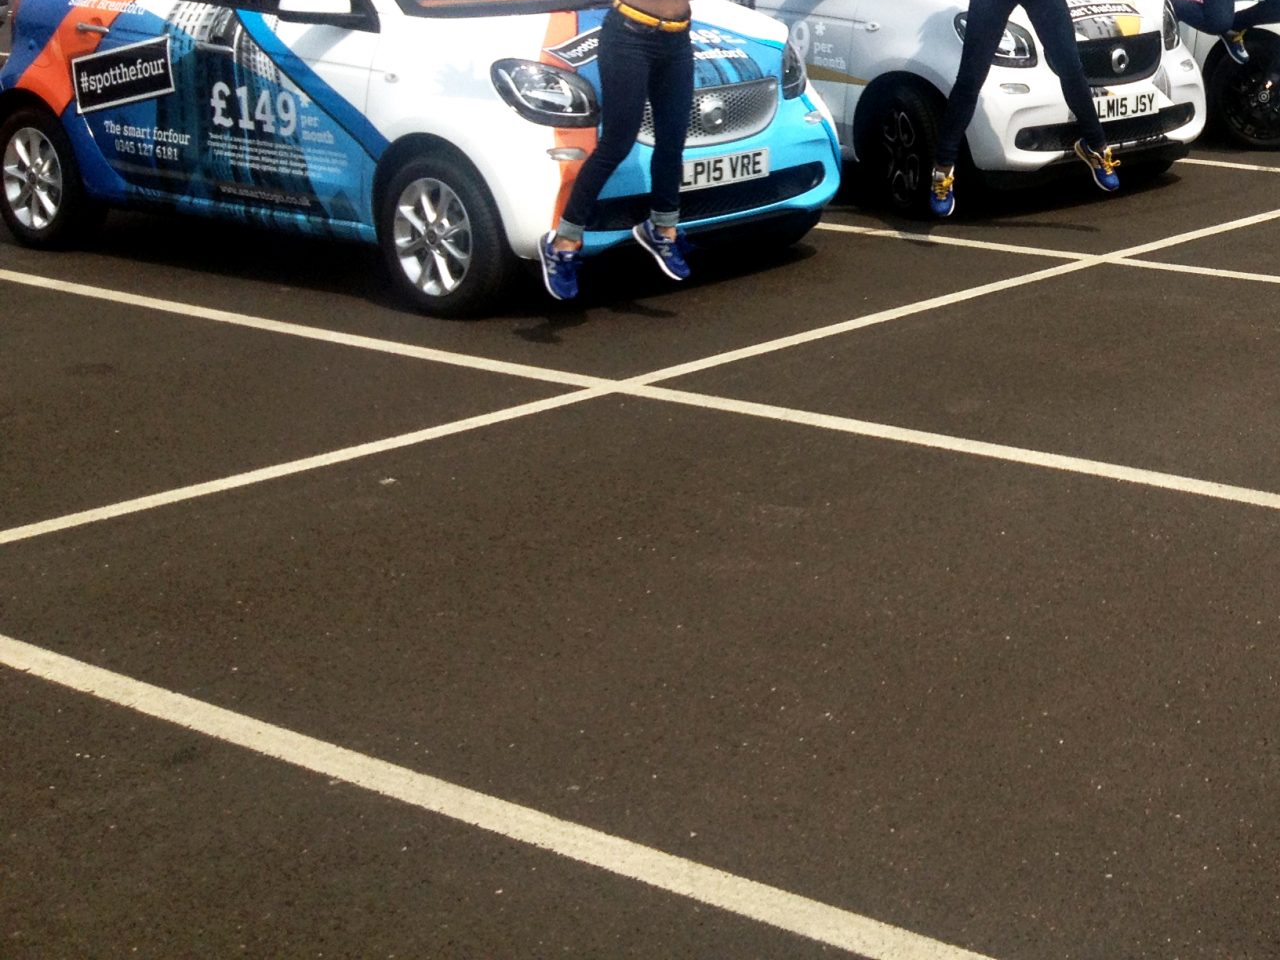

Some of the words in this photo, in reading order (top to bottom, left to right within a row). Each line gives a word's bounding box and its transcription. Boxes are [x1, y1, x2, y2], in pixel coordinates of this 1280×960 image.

[813, 41, 834, 55] per
[79, 58, 166, 94] #spotthefour
[1097, 97, 1128, 120] LM15
[1131, 93, 1155, 114] JSY
[103, 120, 121, 135] The
[122, 124, 151, 139] smart
[152, 127, 192, 146] forfour
[301, 129, 335, 145] month
[729, 151, 763, 179] VRE
